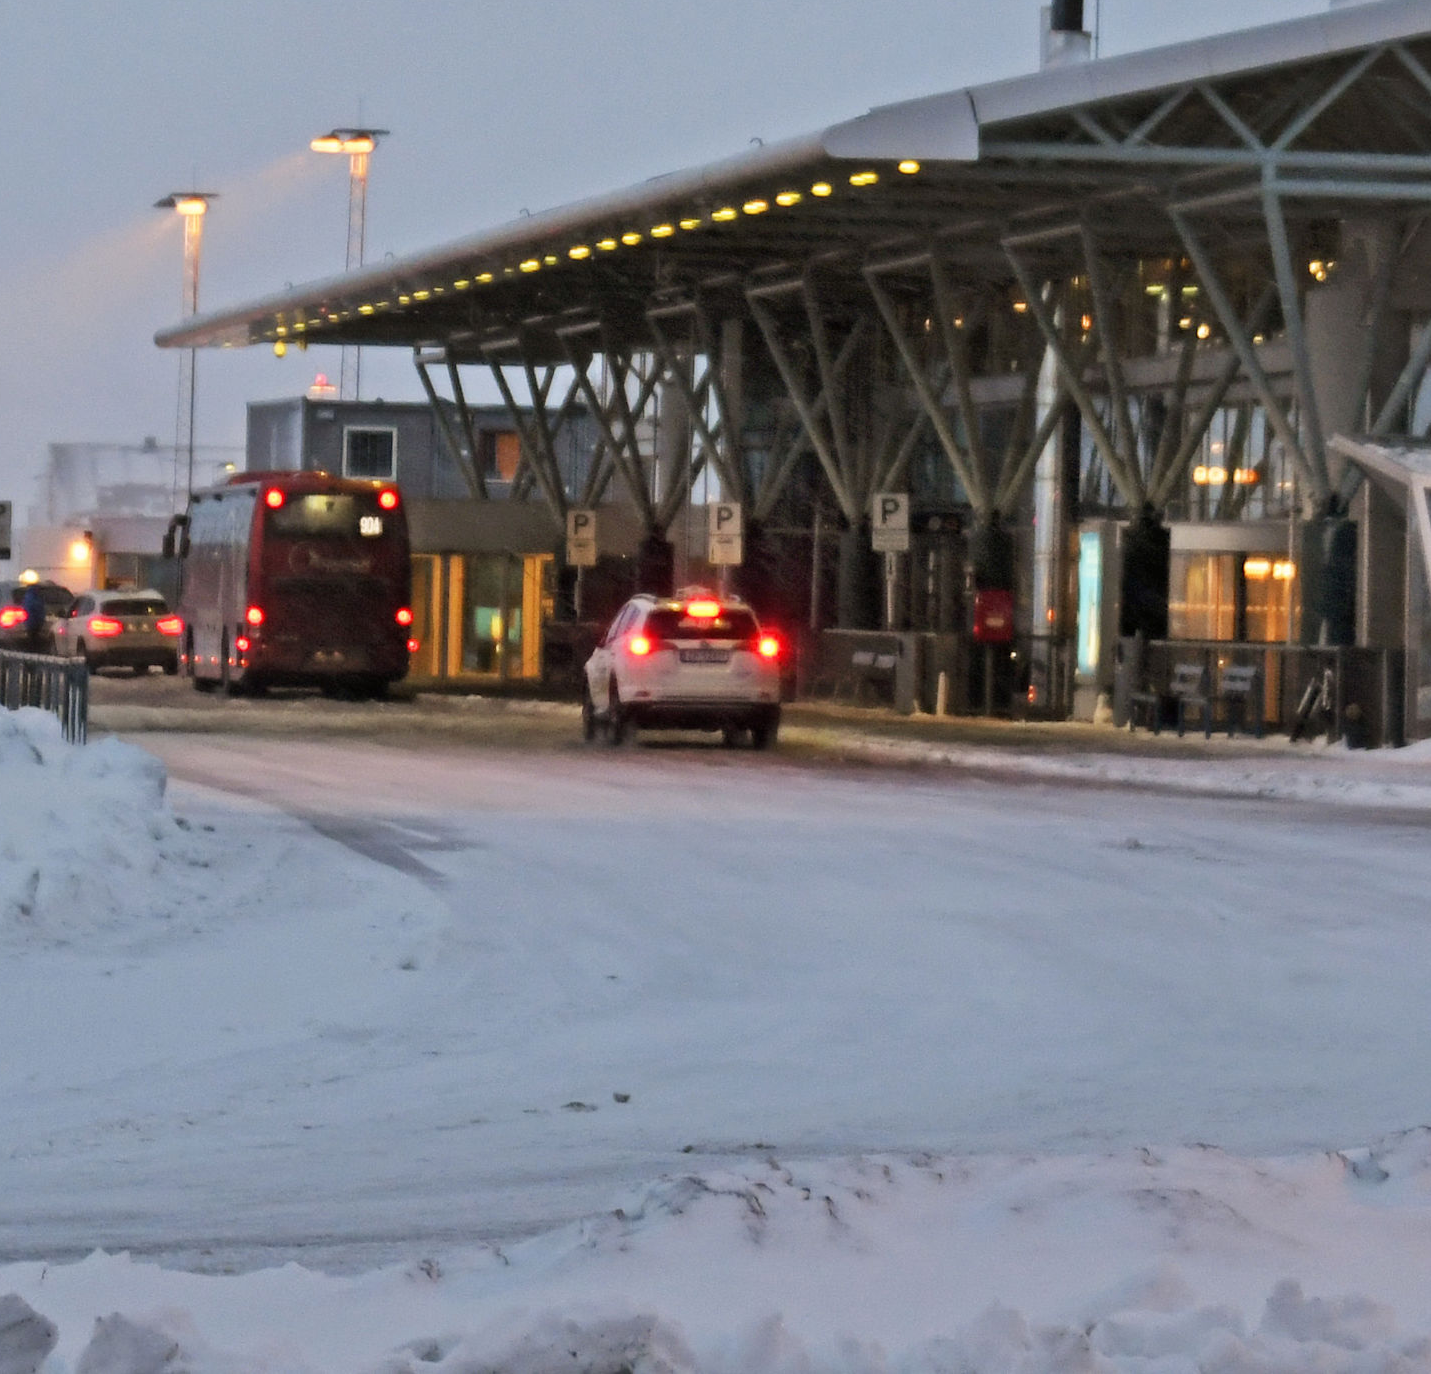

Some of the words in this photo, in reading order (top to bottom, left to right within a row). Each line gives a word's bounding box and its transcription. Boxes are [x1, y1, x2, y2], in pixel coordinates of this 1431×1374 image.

[717, 506, 734, 531] P
[881, 498, 901, 524] P
[574, 513, 589, 536] P
